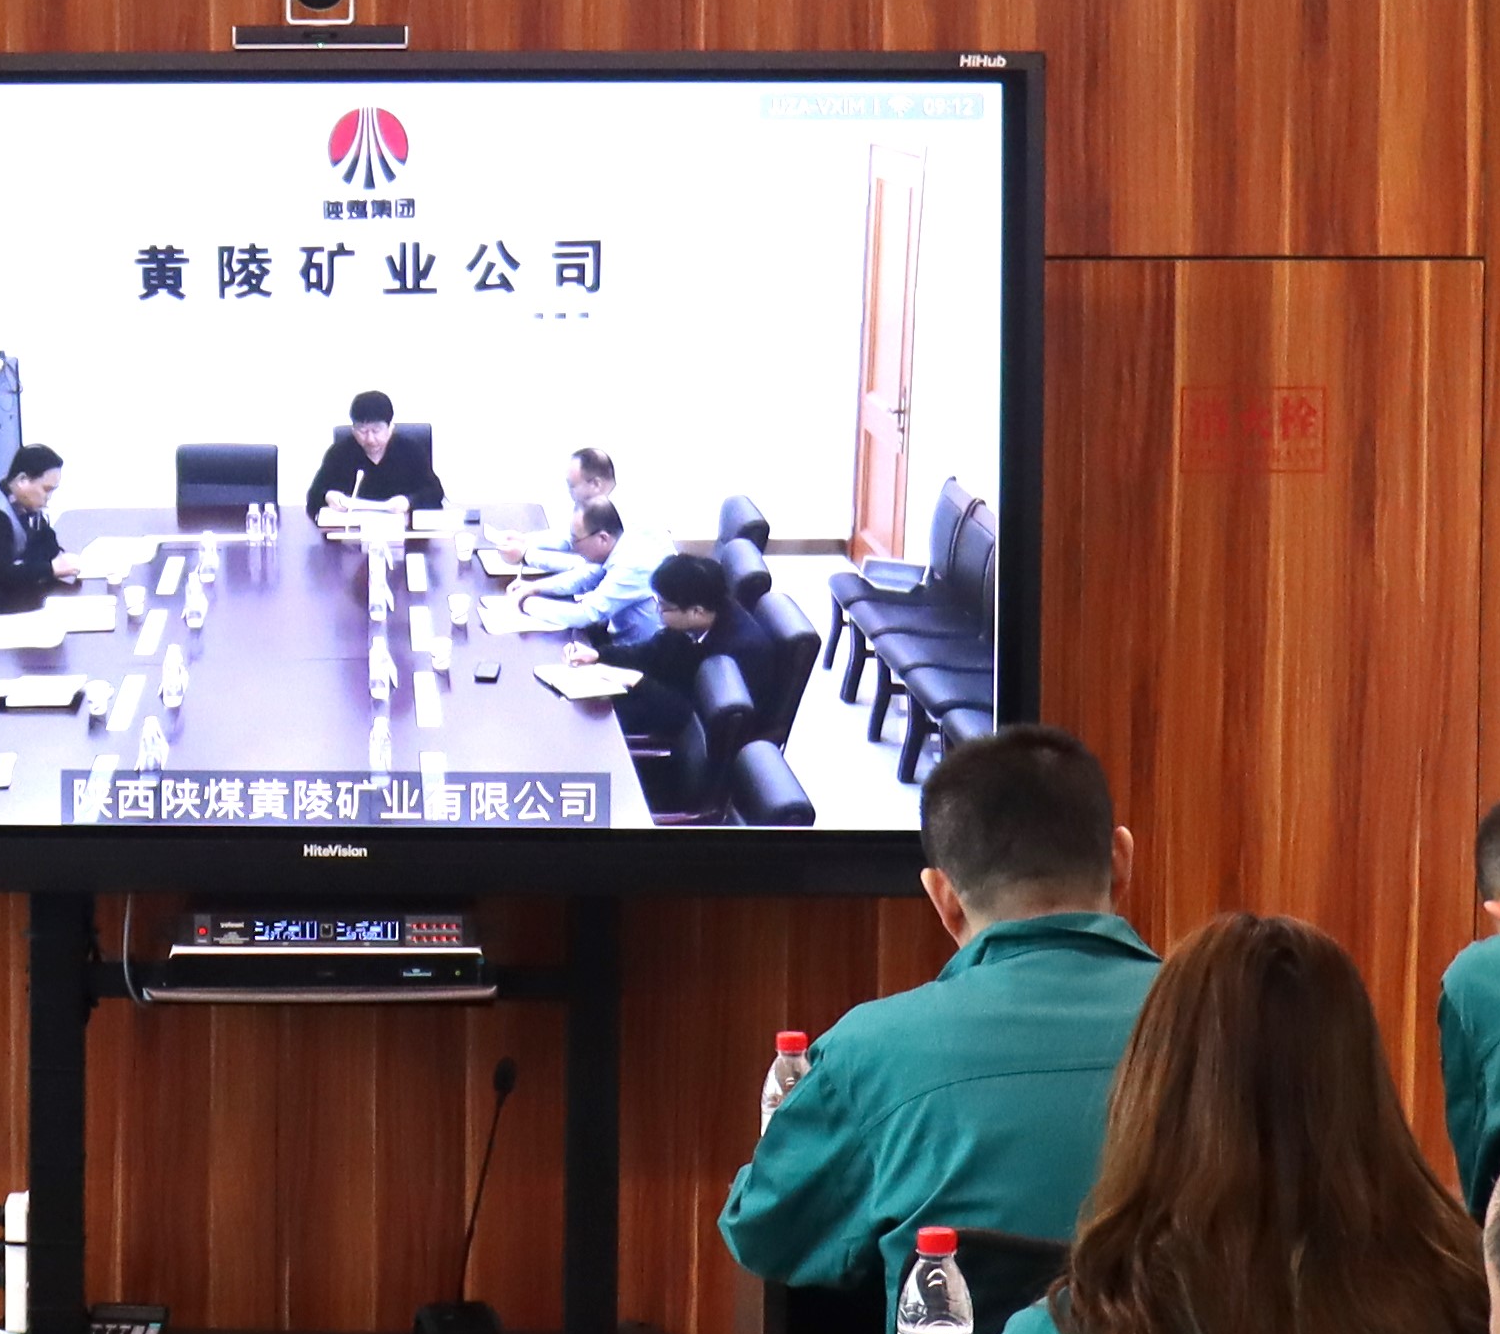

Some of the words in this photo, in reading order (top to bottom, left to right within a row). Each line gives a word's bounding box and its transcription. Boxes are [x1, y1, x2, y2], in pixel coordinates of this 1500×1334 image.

[959, 54, 1007, 67] HiHub
[134, 239, 602, 301] 黄陵矿业公司
[72, 778, 599, 823] 陕西陕煤黄陵矿业有限公司
[303, 843, 368, 858] HiteVision
